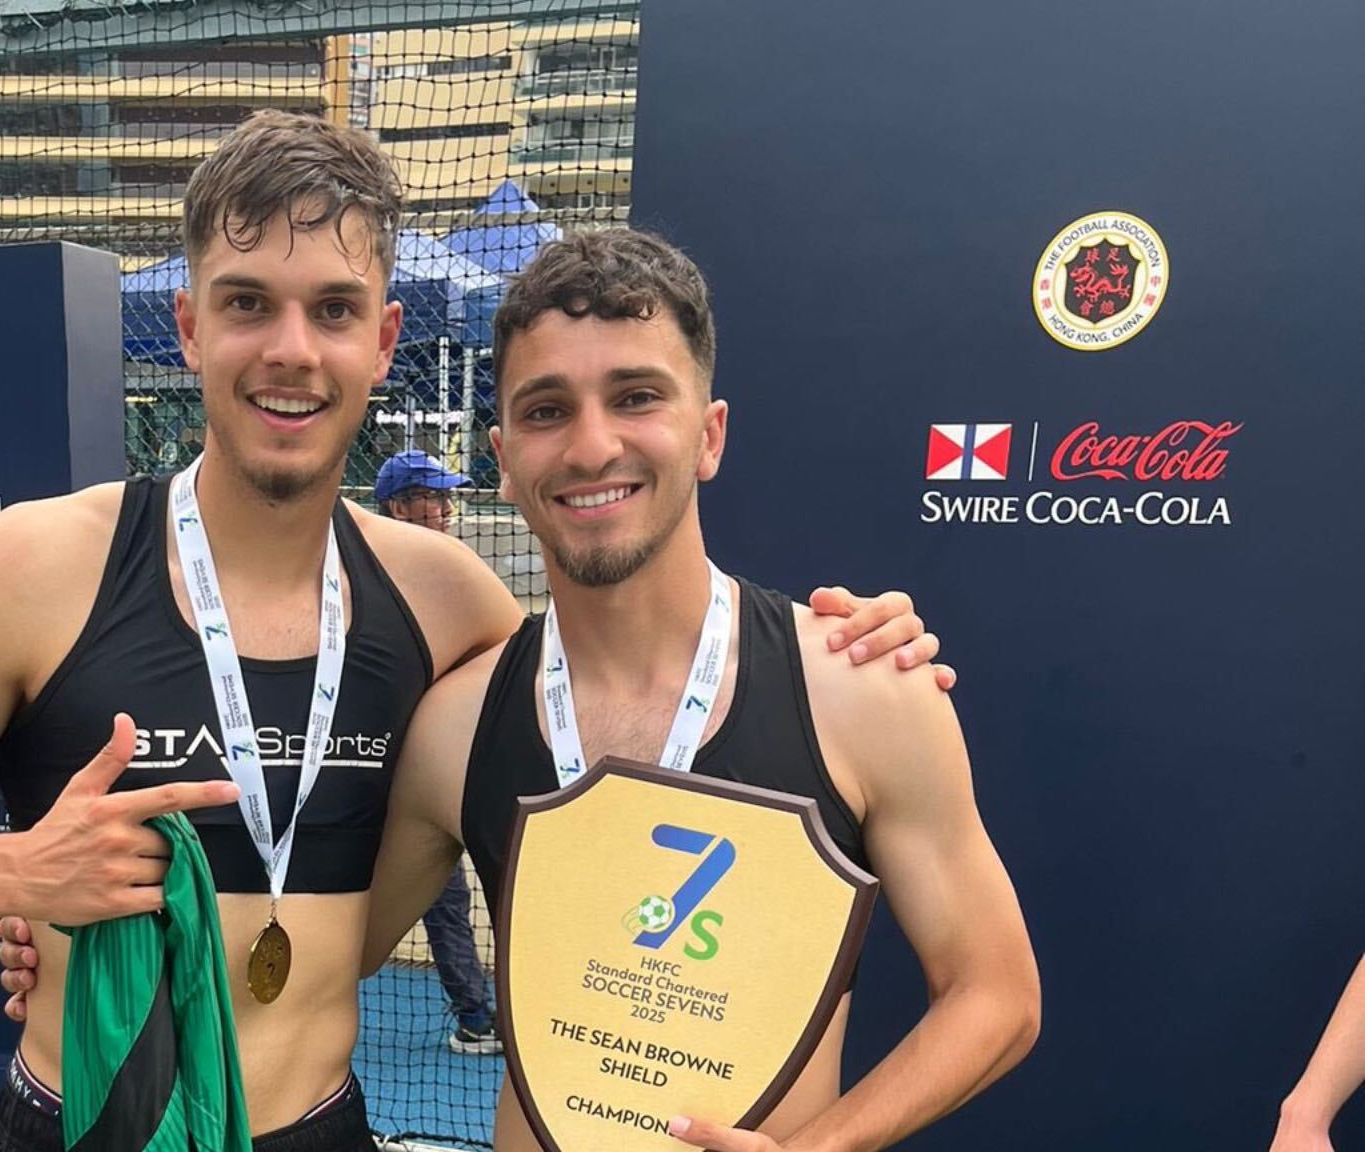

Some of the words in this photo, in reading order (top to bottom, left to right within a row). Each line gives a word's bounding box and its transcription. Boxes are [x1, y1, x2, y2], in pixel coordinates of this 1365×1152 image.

[1044, 252, 1060, 270] THE
[1058, 219, 1108, 252] FOOTBALL
[1111, 220, 1161, 268] ASSOCIATION
[1048, 315, 1075, 339] HONG
[1112, 313, 1144, 338] CHINA
[1050, 420, 1245, 481] Coca-Cola
[920, 491, 1019, 523] SWIRE
[1026, 491, 1231, 524] COCA-COLA
[135, 724, 388, 758] STASports
[587, 959, 651, 986] Standard
[656, 976, 728, 1004] Chartered
[641, 956, 682, 976] HKFC
[582, 974, 652, 1003] SOCCER
[655, 993, 725, 1021] SEVENS
[631, 1005, 666, 1023] 2025
[550, 1018, 587, 1042] THE
[590, 1030, 641, 1055] SEAN
[645, 1044, 734, 1080] BROWNE
[600, 1057, 668, 1087] SHIELD
[566, 1096, 673, 1135] CHAMPION
